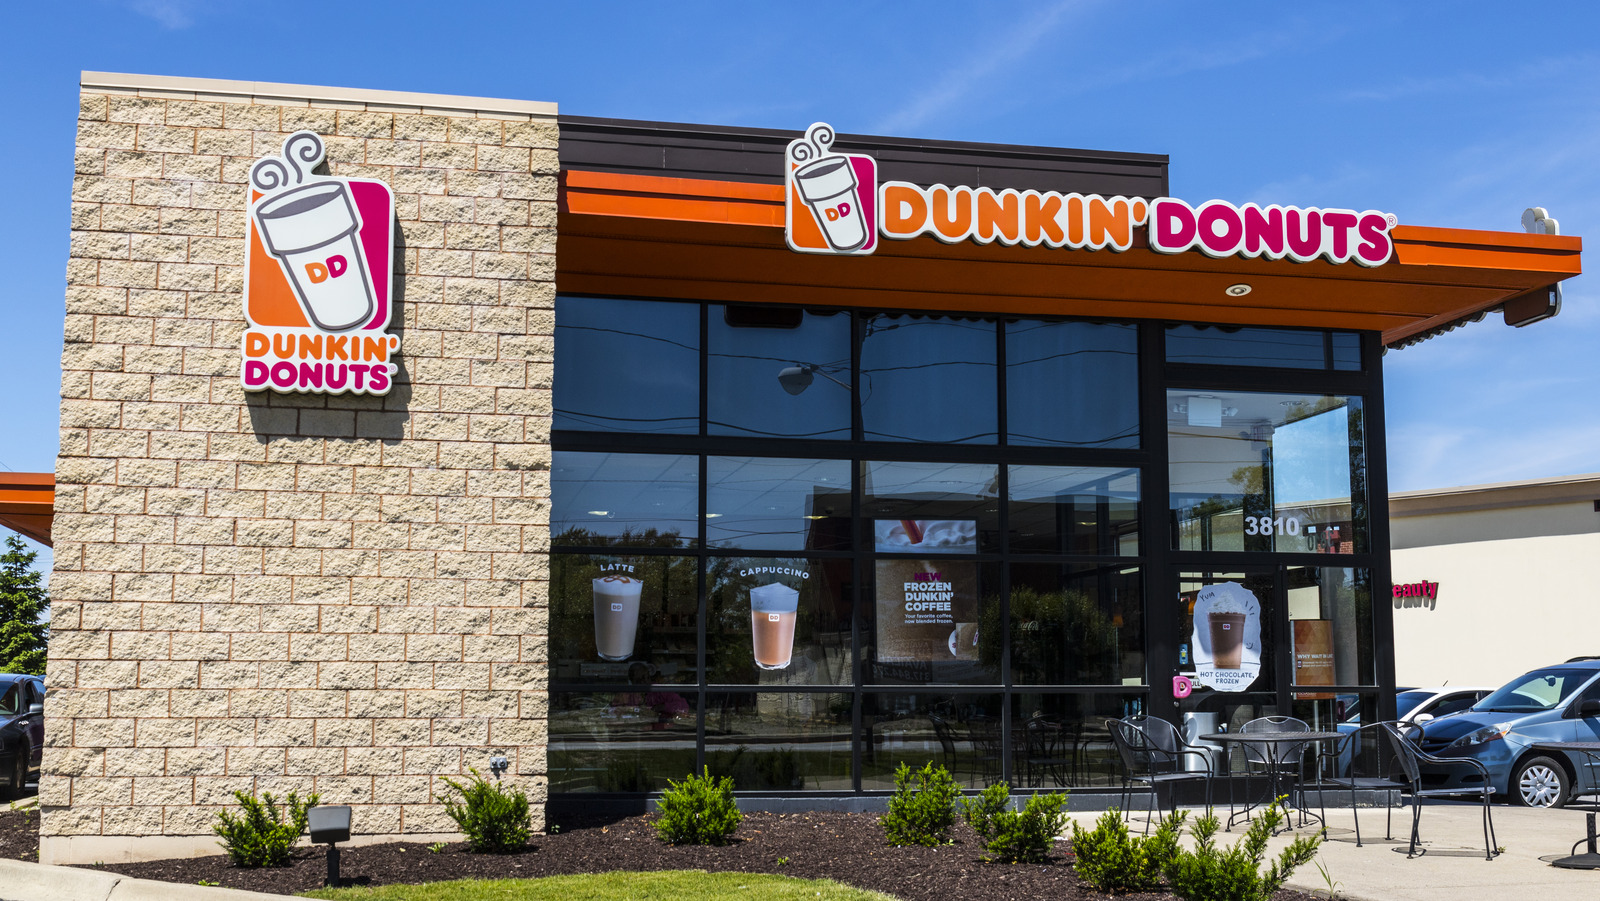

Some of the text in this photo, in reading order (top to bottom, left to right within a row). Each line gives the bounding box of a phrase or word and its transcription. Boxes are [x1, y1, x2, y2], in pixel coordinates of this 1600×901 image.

[824, 202, 851, 222] DD
[884, 185, 1147, 247] DUNKIN'
[304, 254, 348, 284] DD
[245, 332, 398, 362] DUNKIN'
[1244, 516, 1300, 536] 3810
[600, 563, 635, 573] LATTE
[740, 566, 809, 579] CAPPUCCINO
[914, 572, 942, 581] NEW
[903, 582, 952, 591] FROZEN
[1392, 580, 1439, 600] eauty
[905, 592, 954, 601] DUNKIN'
[904, 602, 951, 611] COFFEE
[1215, 671, 1255, 679] CHOCOLATE,
